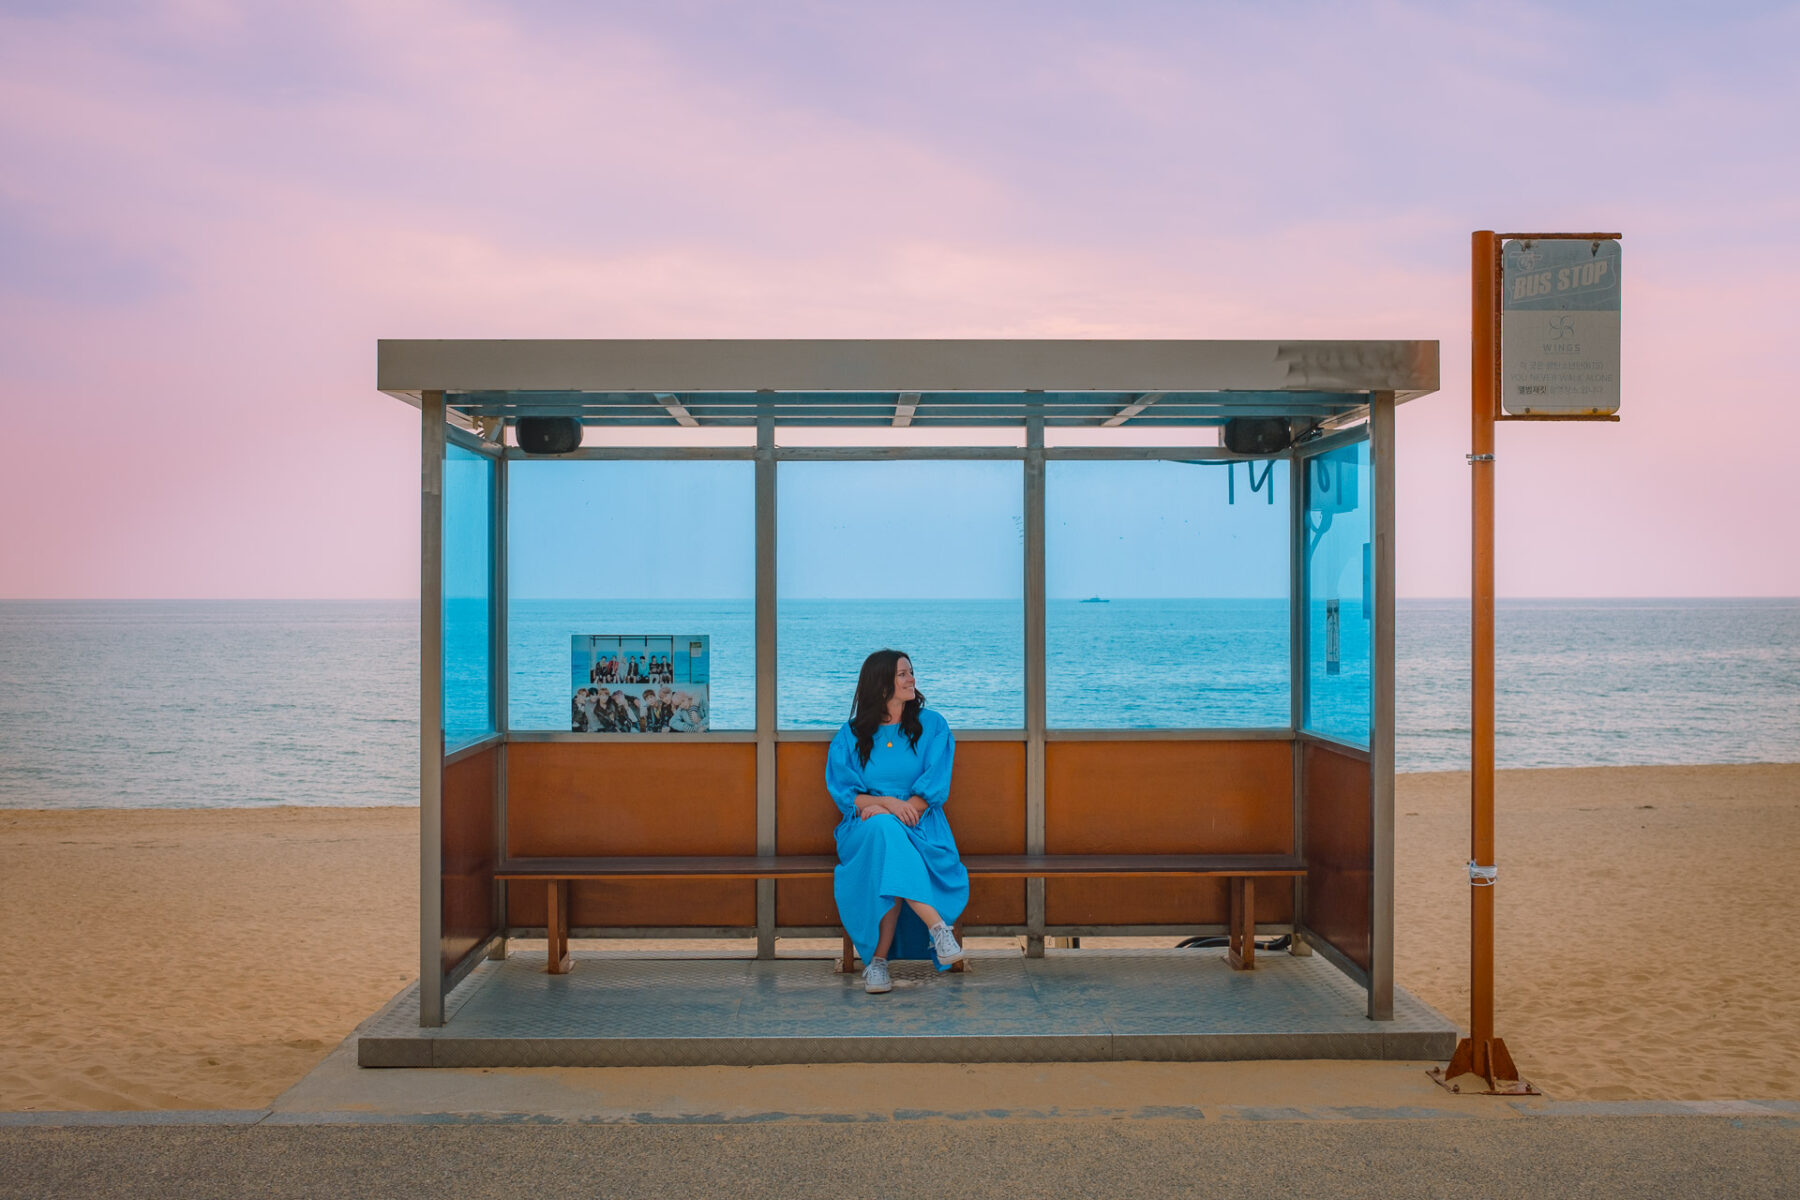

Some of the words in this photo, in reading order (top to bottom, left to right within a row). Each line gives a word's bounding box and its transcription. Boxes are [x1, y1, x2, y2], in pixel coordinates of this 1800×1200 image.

[1513, 272, 1552, 299] BUS
[1557, 261, 1607, 290] STOP
[1543, 343, 1581, 352] WINGS
